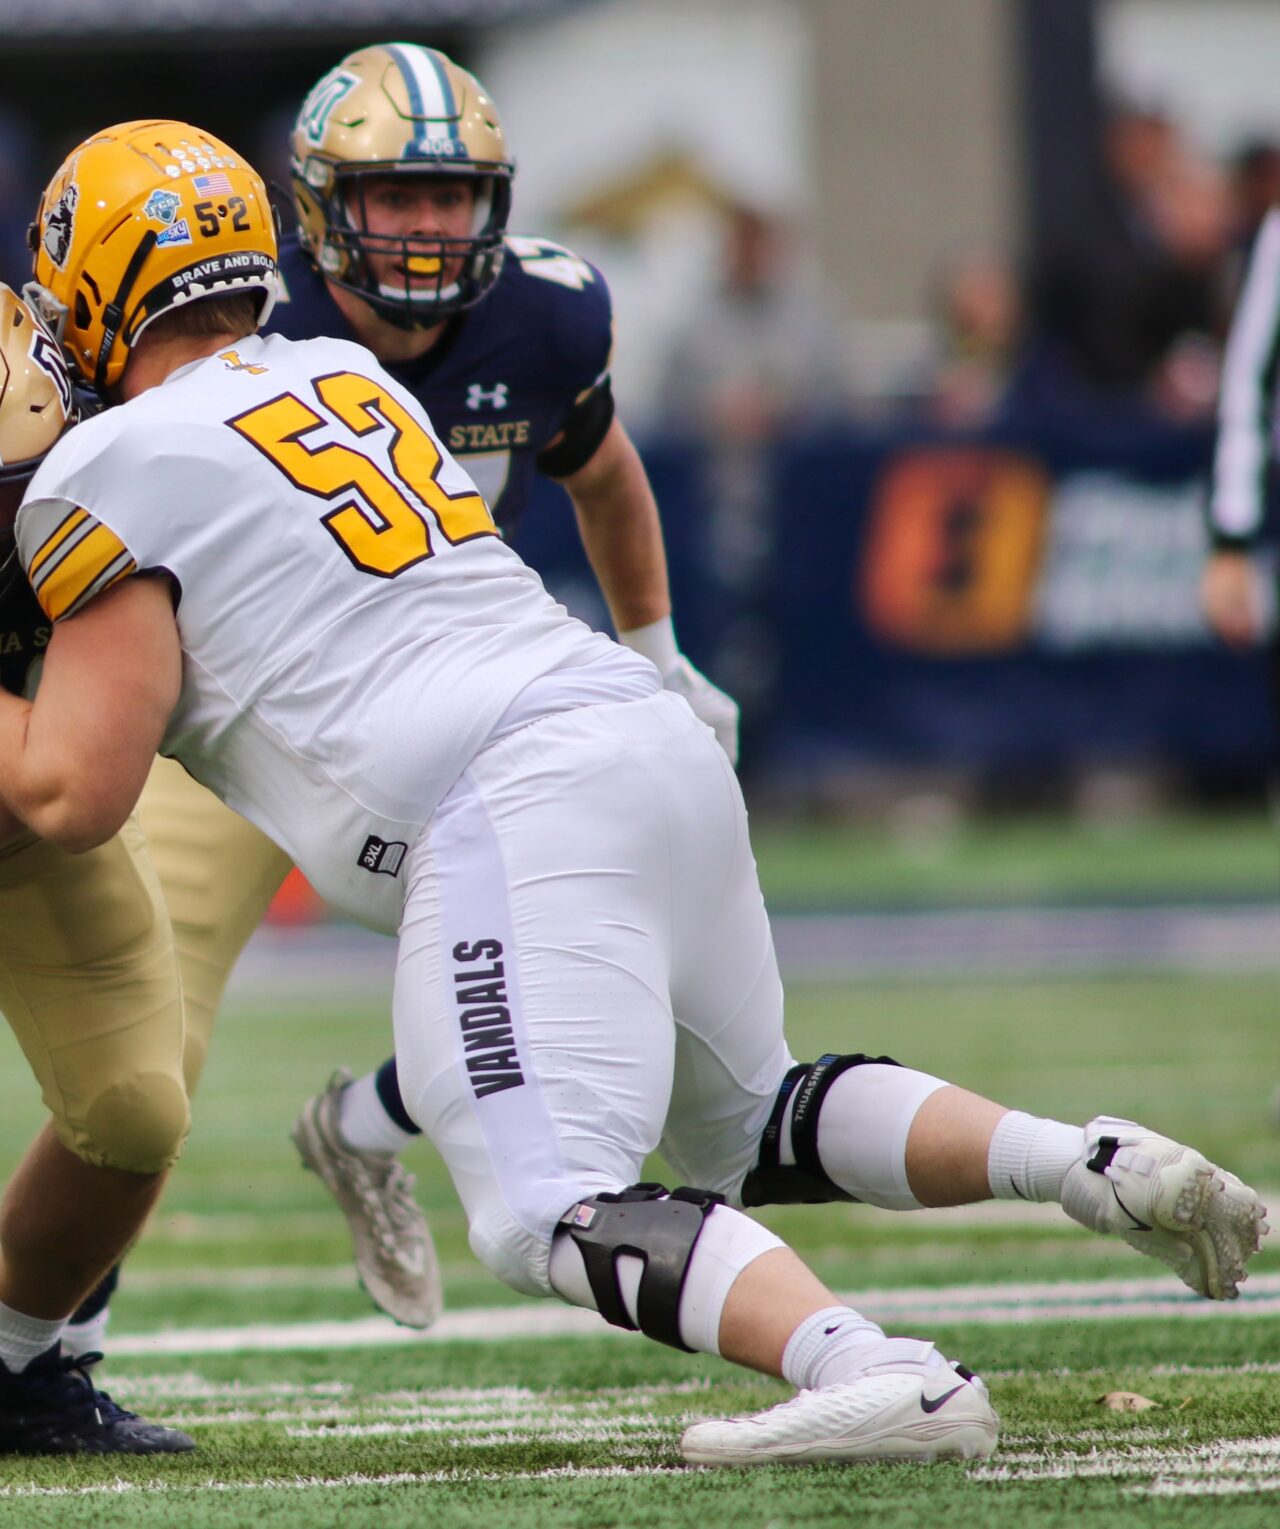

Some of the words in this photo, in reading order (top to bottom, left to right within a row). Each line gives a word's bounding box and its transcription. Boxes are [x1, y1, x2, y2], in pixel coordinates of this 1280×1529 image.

[419, 139, 454, 155] 406
[172, 261, 221, 288] BRAVE
[224, 256, 250, 270] AND
[252, 255, 274, 270] BOLD
[450, 421, 530, 448] STATE
[223, 371, 499, 579] 52
[363, 844, 383, 867] 3XL
[453, 938, 526, 1099] VANDALS
[794, 1065, 826, 1122] THUASNE
